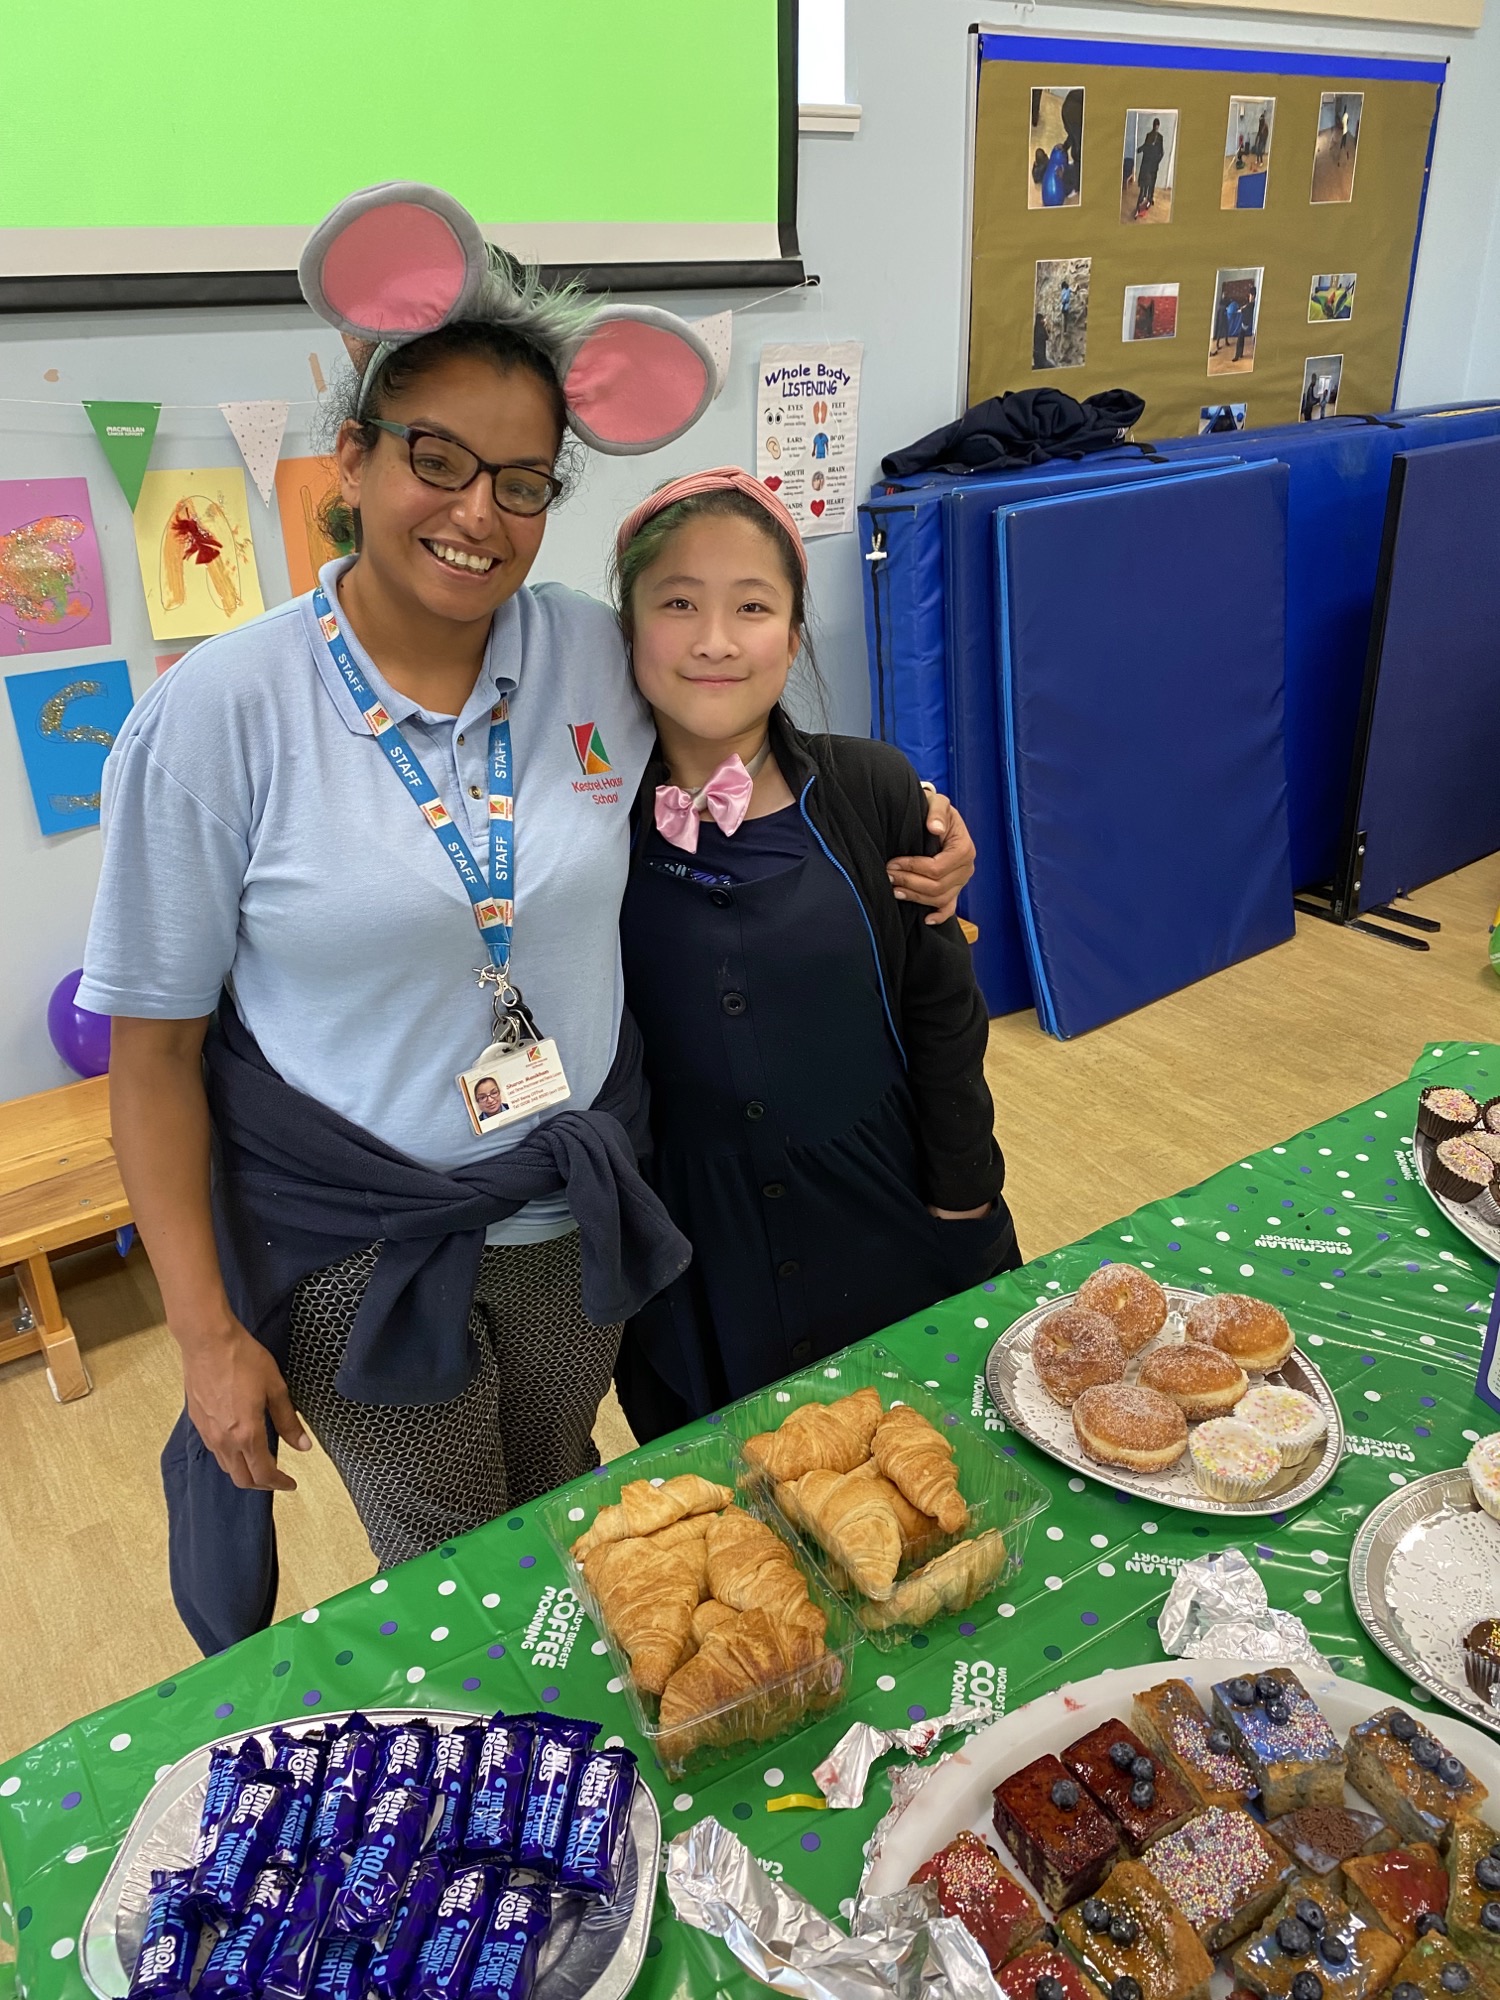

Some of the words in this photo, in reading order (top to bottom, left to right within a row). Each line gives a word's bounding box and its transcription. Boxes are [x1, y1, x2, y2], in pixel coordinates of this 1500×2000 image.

[765, 364, 811, 386] Whole
[817, 364, 850, 386] Body
[783, 380, 837, 398] LISTENING
[338, 653, 364, 693] STAFF
[390, 746, 423, 787] STAFF
[494, 739, 508, 779] STAFF
[571, 780, 602, 793] Kestrel
[601, 777, 623, 790] Hous
[592, 792, 619, 805] School
[448, 842, 478, 885] STAFF
[495, 836, 508, 882] STAFF
[1254, 1239, 1353, 1256] MACMILLAN
[1259, 1234, 1307, 1245] SUPPORT
[1307, 1239, 1349, 1249] CANCER
[1344, 1443, 1416, 1463] MACMI
[1361, 1436, 1411, 1452] CANCER
[1132, 1551, 1188, 1566] UPPORT
[520, 1585, 557, 1650] MORNING
[531, 1587, 579, 1669] COFFEE
[570, 1605, 586, 1632] RLD'S
[556, 1632, 577, 1670] BIGGEST
[994, 1667, 1007, 1711] WORLD'S
[387, 1734, 409, 1775] ROLLS
[434, 1736, 452, 1779] ROLLS
[478, 1732, 497, 1777] ROLLS
[477, 1790, 491, 1807] OF
[578, 1761, 600, 1807] ROLLS
[232, 1784, 256, 1824] ROLLS
[368, 1790, 393, 1833] ROLLS
[527, 1795, 538, 1818] AND
[278, 1799, 302, 1849] MASSIVE
[520, 1821, 533, 1848] ROLL
[233, 1838, 251, 1865] MINI
[562, 1819, 580, 1868] MODEL
[203, 1832, 240, 1890] MIGHTY
[352, 1846, 390, 1891] ROLL
[221, 1864, 242, 1889] BUT
[438, 1879, 464, 1917] ROLLS
[494, 1890, 519, 1930] ROLLS
[231, 1925, 257, 1948] I'M
[425, 1926, 454, 1975] MASSIVE
[449, 1933, 463, 1953] MINI
[493, 1941, 509, 1957] OF
[153, 1935, 177, 1974] ROLLS
[202, 1939, 233, 1977] ROLL
[220, 1950, 246, 1972] ON
[315, 1942, 344, 1992] IGHTY
[479, 1942, 494, 1963] AND
[508, 1943, 525, 1963] THE
[334, 1962, 353, 1987] BUT
[470, 1965, 488, 1992] ROLL
[482, 1957, 505, 1987] CHOC
[499, 1961, 520, 1990] KING
